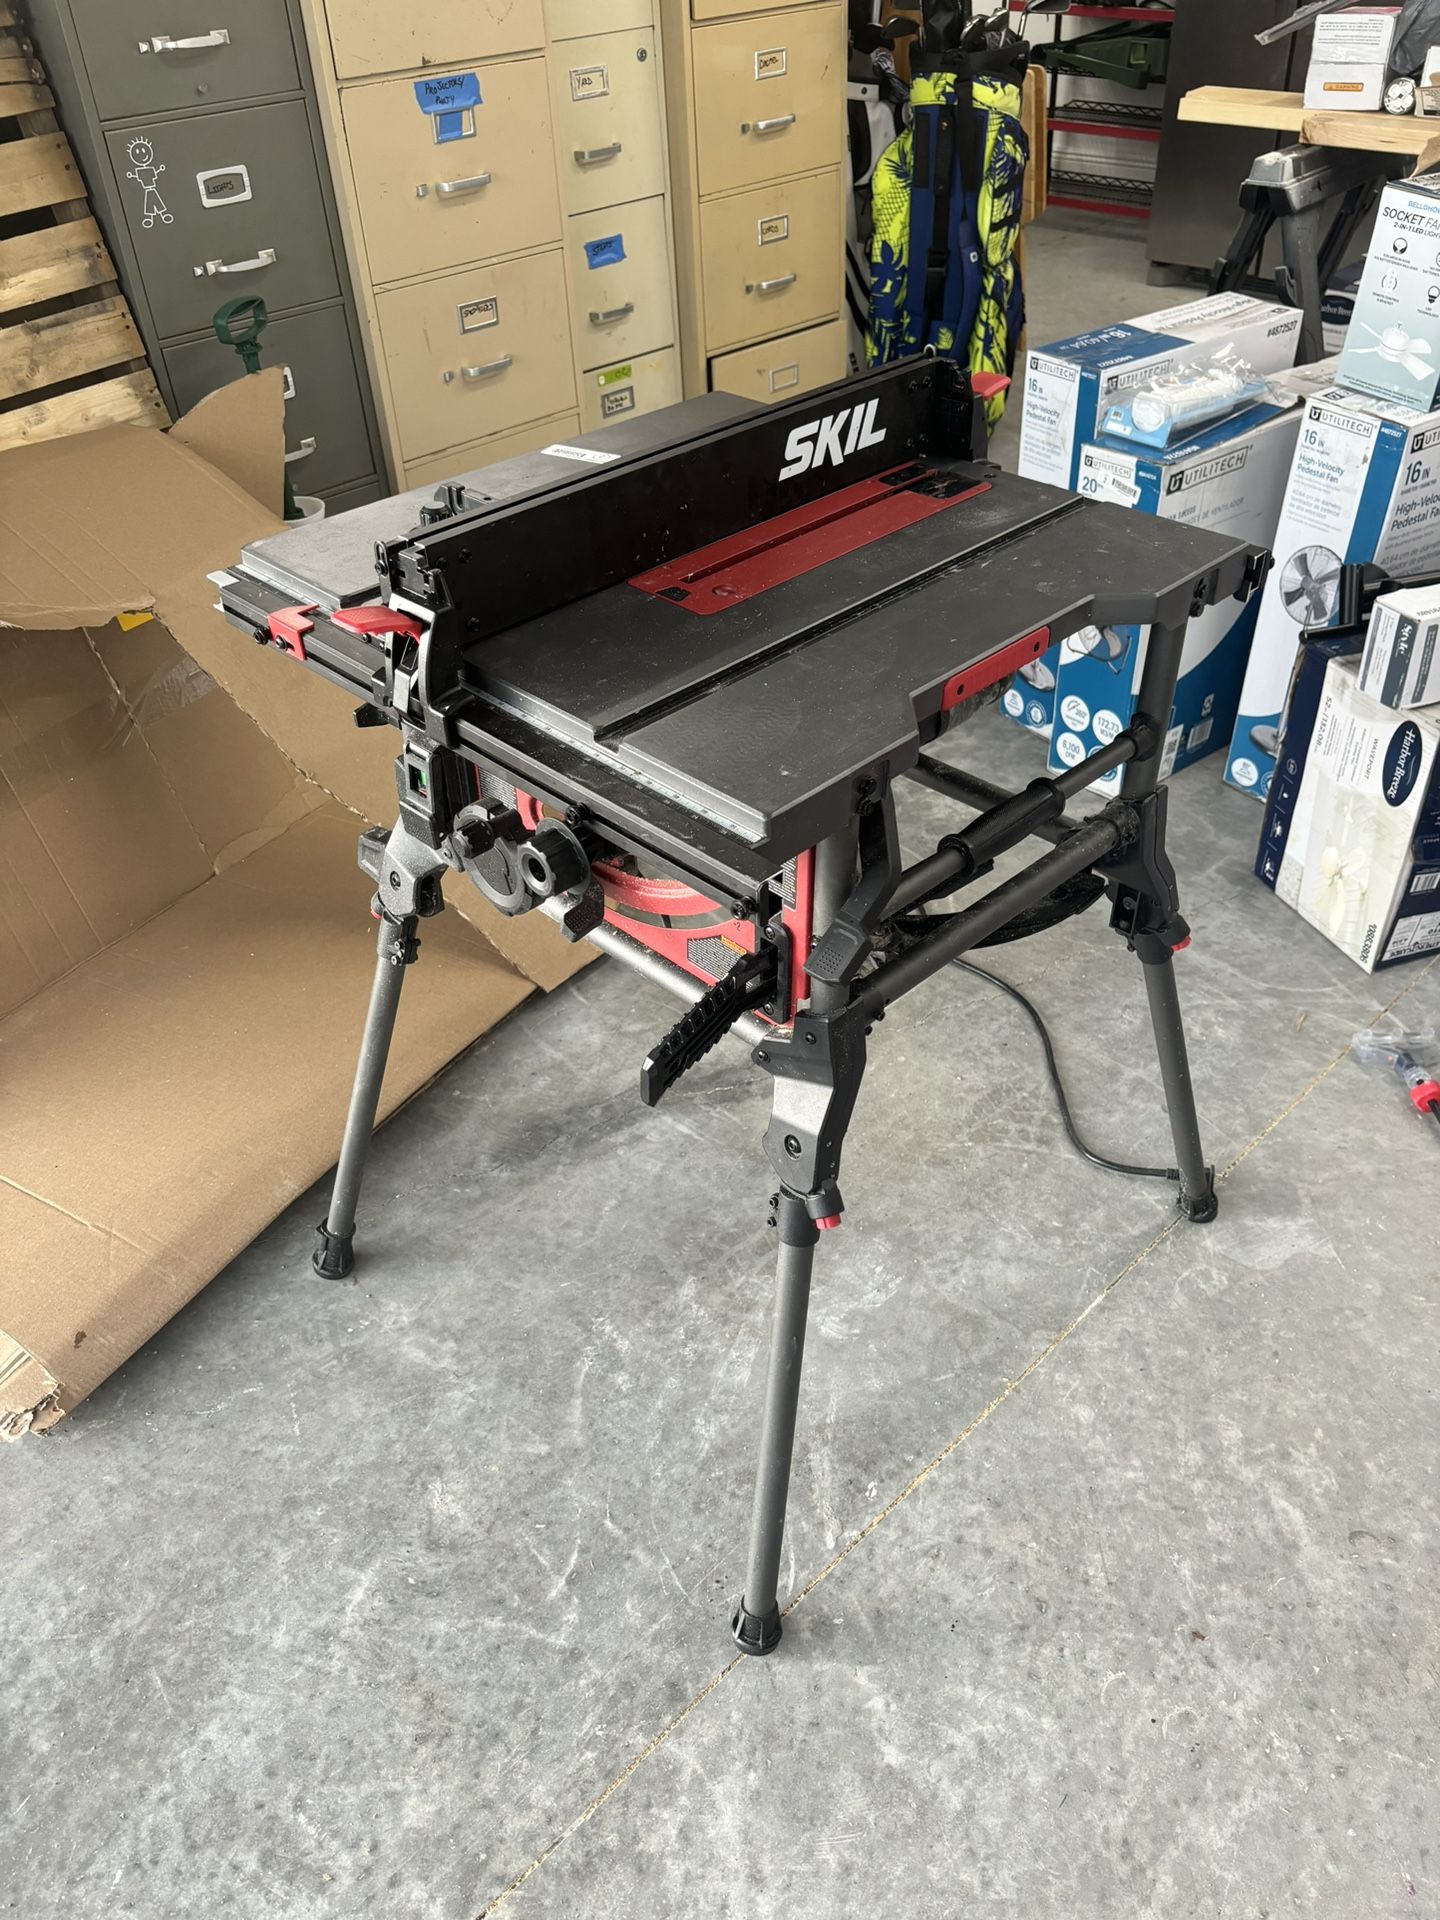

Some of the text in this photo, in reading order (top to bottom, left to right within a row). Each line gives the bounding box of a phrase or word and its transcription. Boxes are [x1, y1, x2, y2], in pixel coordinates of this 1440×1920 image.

[1382, 206, 1426, 226] SOCKET
[1393, 221, 1412, 232] 2-IN-1
[1412, 226, 1424, 235] LED
[1267, 319, 1298, 338] #4872527
[1038, 362, 1075, 379] UTILITECH
[1119, 362, 1168, 387] UTILITECH
[1028, 377, 1038, 393] 16
[1026, 409, 1057, 425] Pedestal Fan
[1027, 400, 1060, 418] High-Velocity
[1322, 412, 1370, 435] UTILITECH
[778, 398, 887, 482] SKIL
[1303, 428, 1318, 446] 16
[1093, 459, 1129, 476] UTILITECH
[1184, 451, 1245, 486] UTILITECH
[1297, 463, 1339, 483] Pedestal Fan
[1298, 453, 1345, 477] High-Velocity
[1404, 460, 1422, 487] 16
[1421, 466, 1431, 480] IN
[1082, 475, 1098, 494] 20
[1390, 509, 1429, 533] Pedestal
[1325, 696, 1333, 708] 52
[1316, 718, 1328, 746] 132,08
[1398, 728, 1416, 767] Harbor
[1364, 738, 1379, 781] WAVEPORT
[1387, 764, 1406, 800] Breeze
